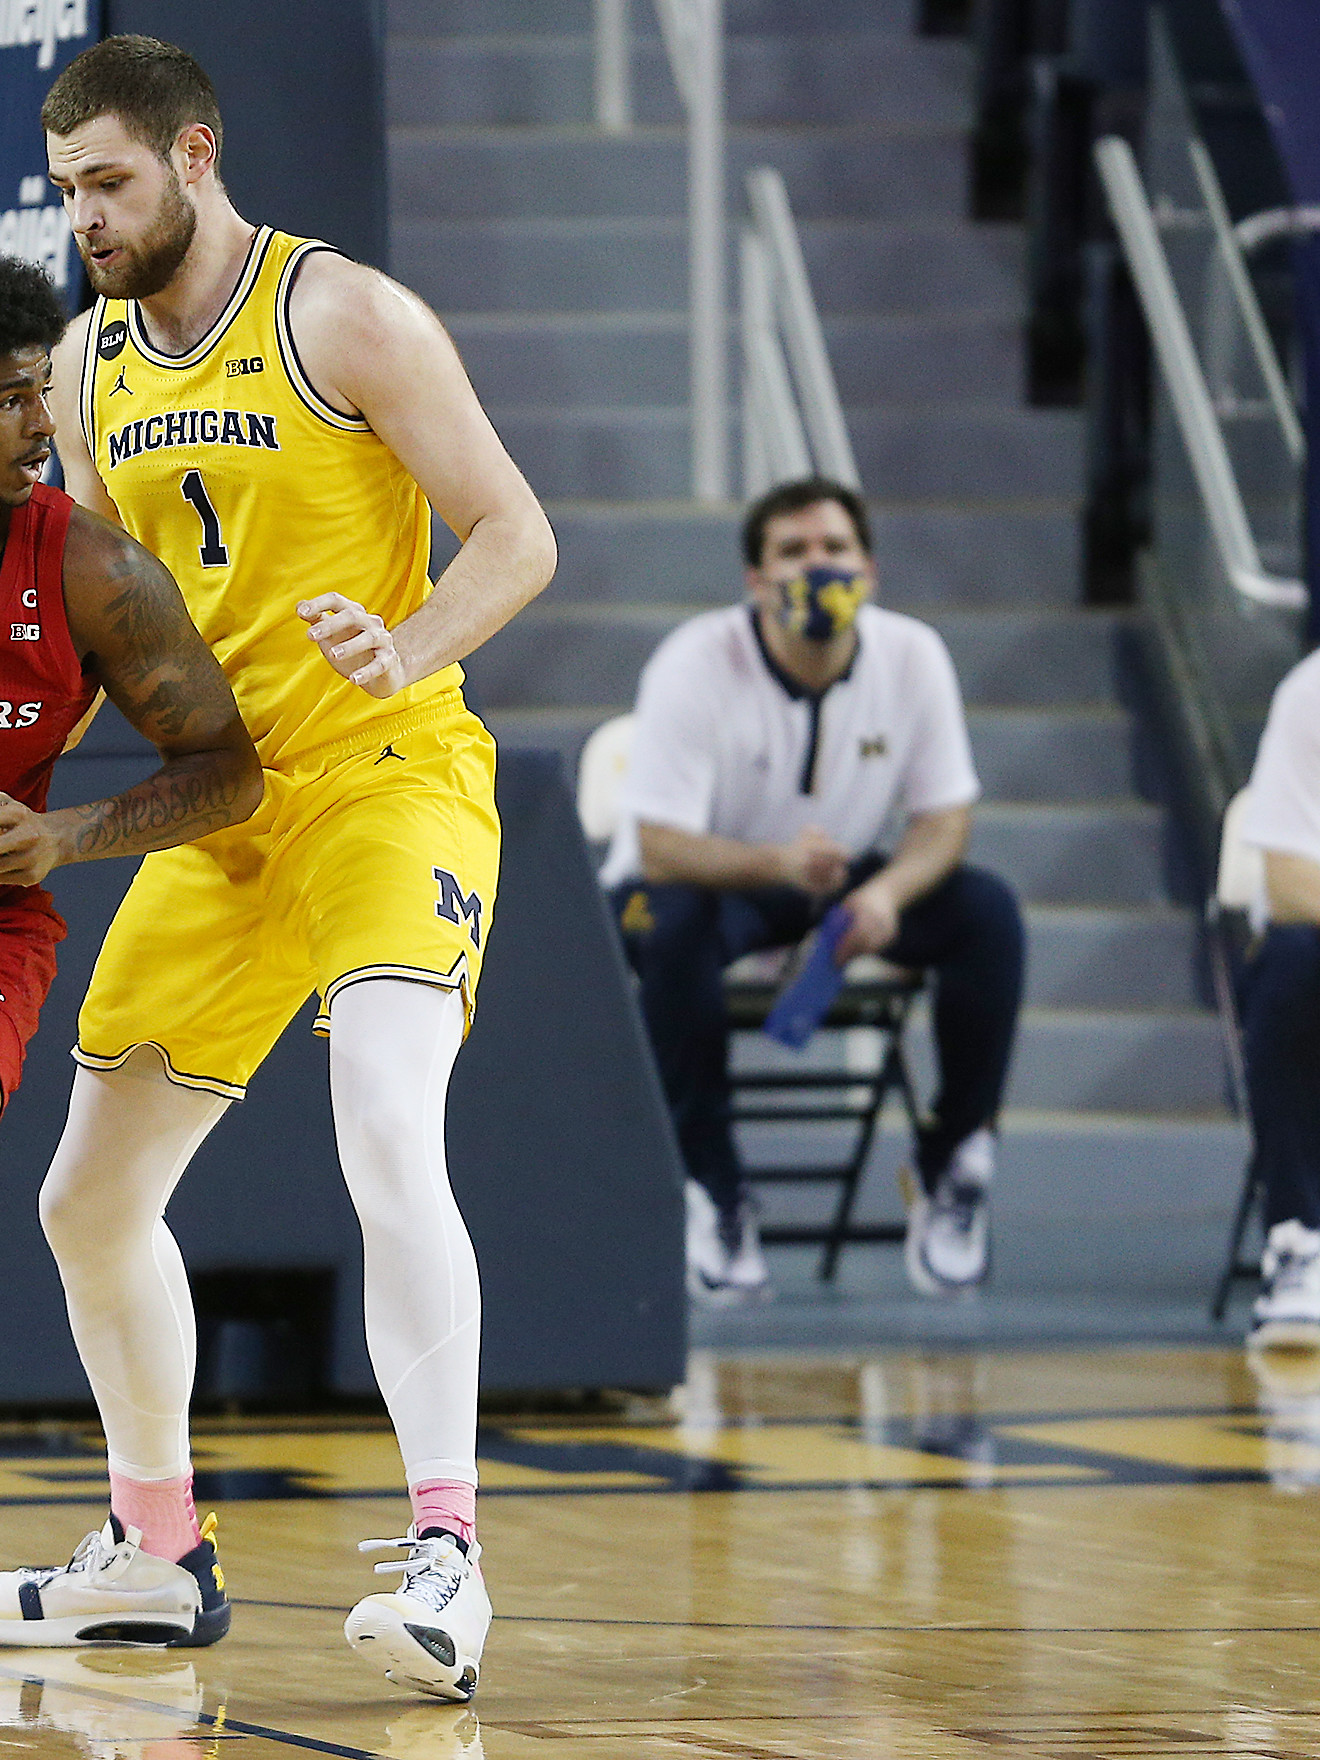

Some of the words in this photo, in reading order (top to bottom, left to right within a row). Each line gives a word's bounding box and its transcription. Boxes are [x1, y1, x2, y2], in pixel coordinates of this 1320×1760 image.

[100, 331, 125, 350] BLM
[108, 409, 282, 471] MICHIGAN
[180, 469, 230, 568] 1
[431, 865, 483, 951] M
